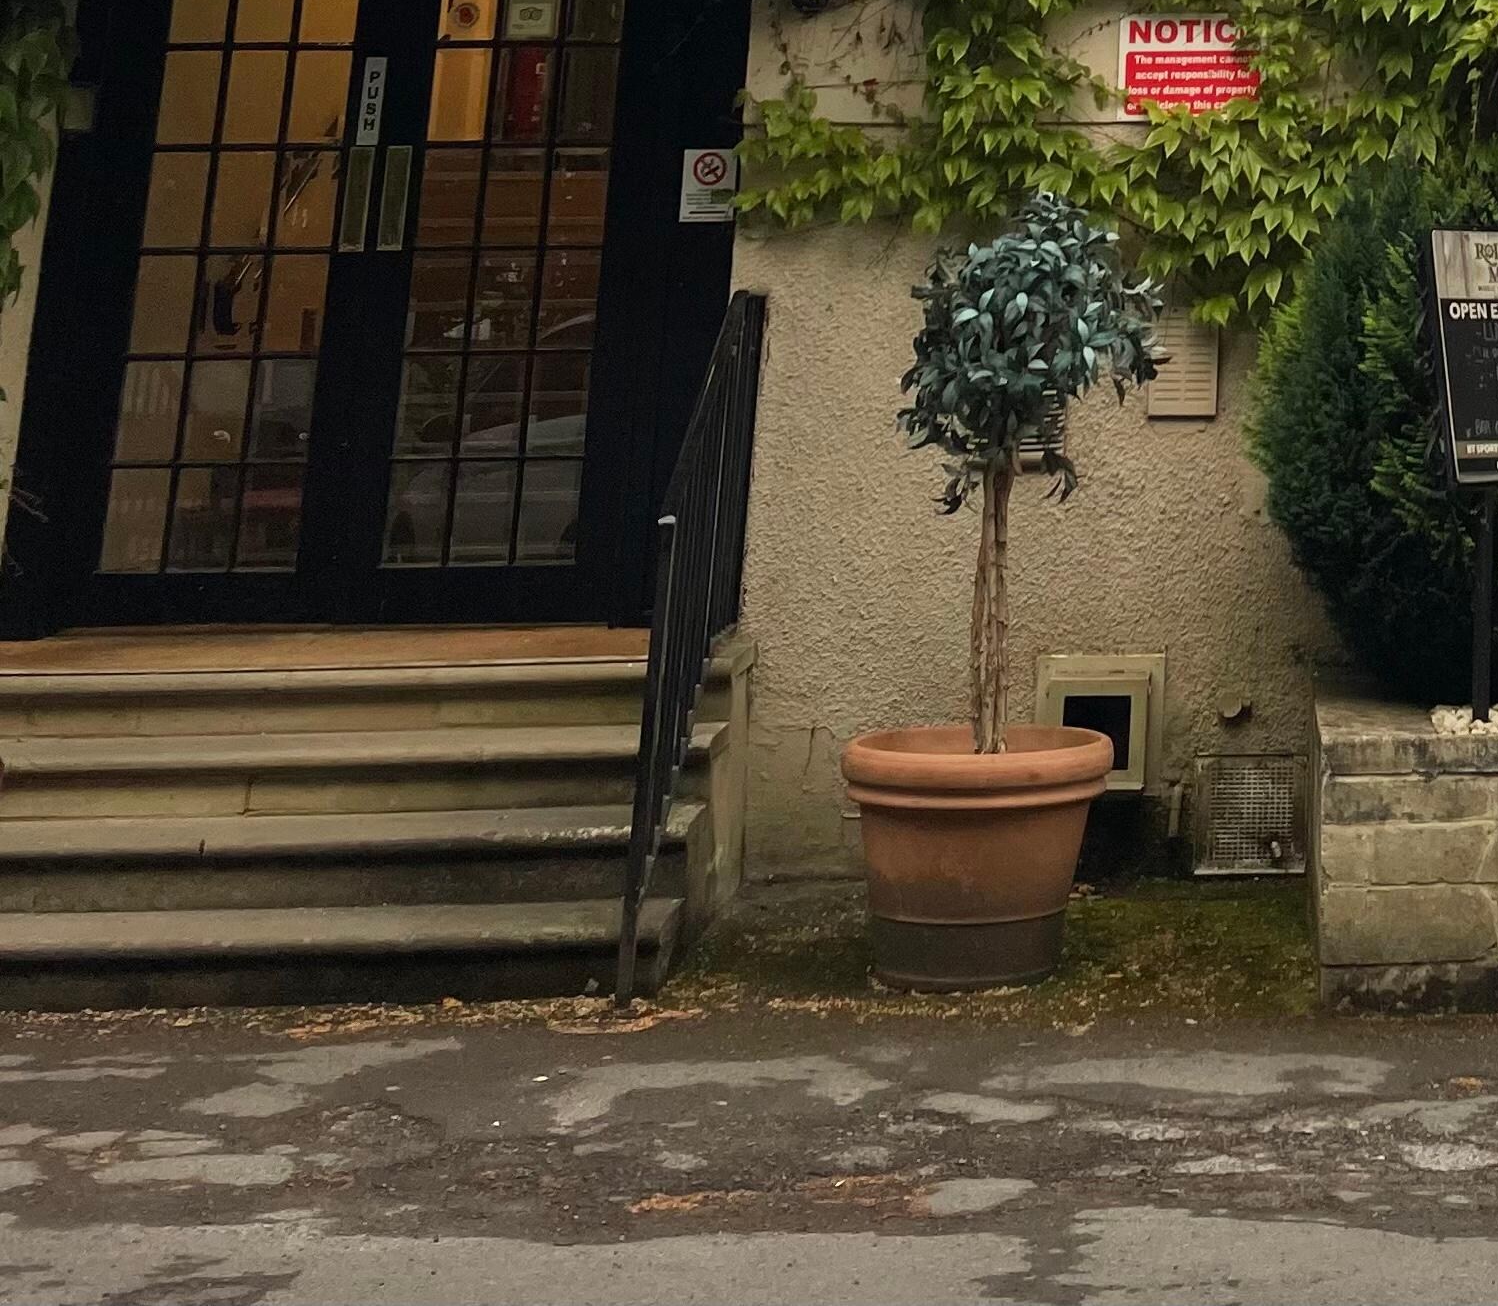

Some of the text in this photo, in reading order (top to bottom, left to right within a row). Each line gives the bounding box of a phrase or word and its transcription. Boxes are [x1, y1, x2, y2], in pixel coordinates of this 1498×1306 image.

[1129, 19, 1244, 43] NOTIC
[1134, 54, 1250, 66] The management canno
[1135, 70, 1169, 81] accept
[1170, 69, 1236, 81] responsibility
[1128, 84, 1257, 97] loss or damage of property
[363, 71, 381, 131] PUSH
[1192, 100, 1212, 110] this
[1449, 302, 1488, 320] OPEN
